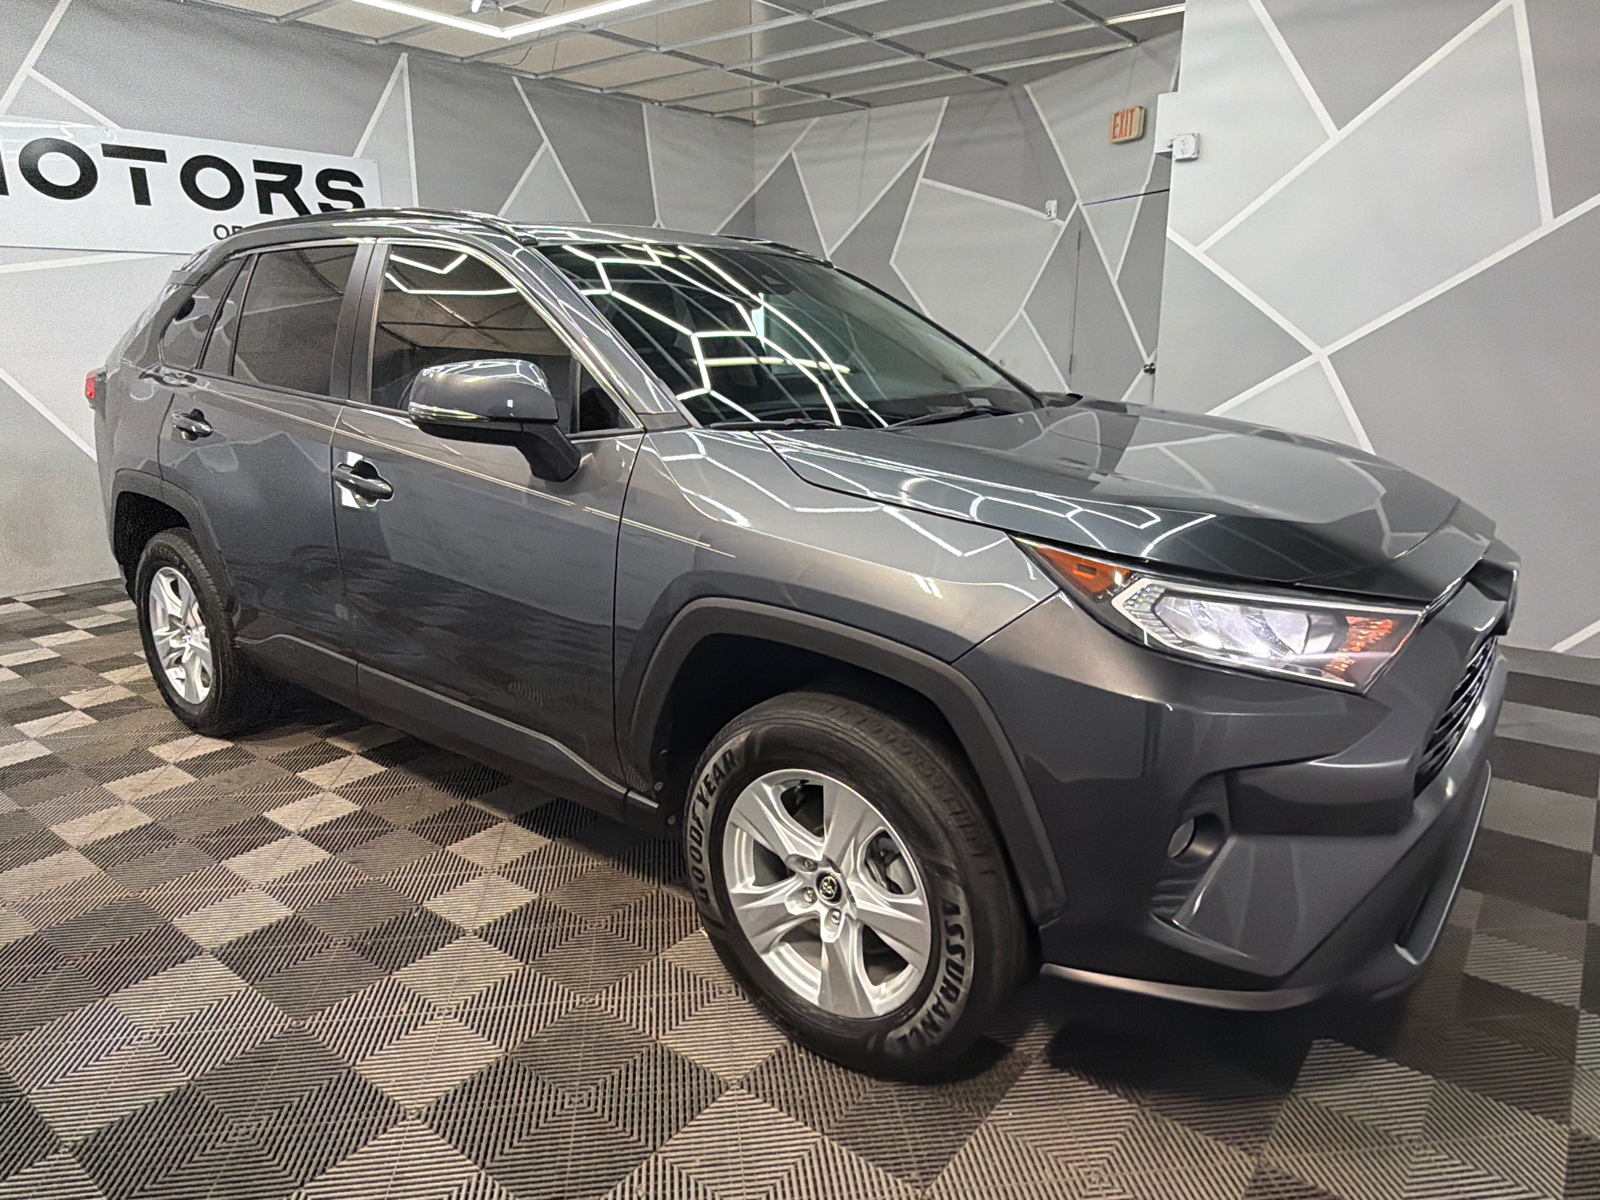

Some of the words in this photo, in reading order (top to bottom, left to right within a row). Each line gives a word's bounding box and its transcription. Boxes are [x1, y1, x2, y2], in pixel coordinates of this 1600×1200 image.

[1112, 108, 1136, 139] EXIT
[0, 137, 366, 215] OTORS
[689, 748, 737, 904] GOODYEAR
